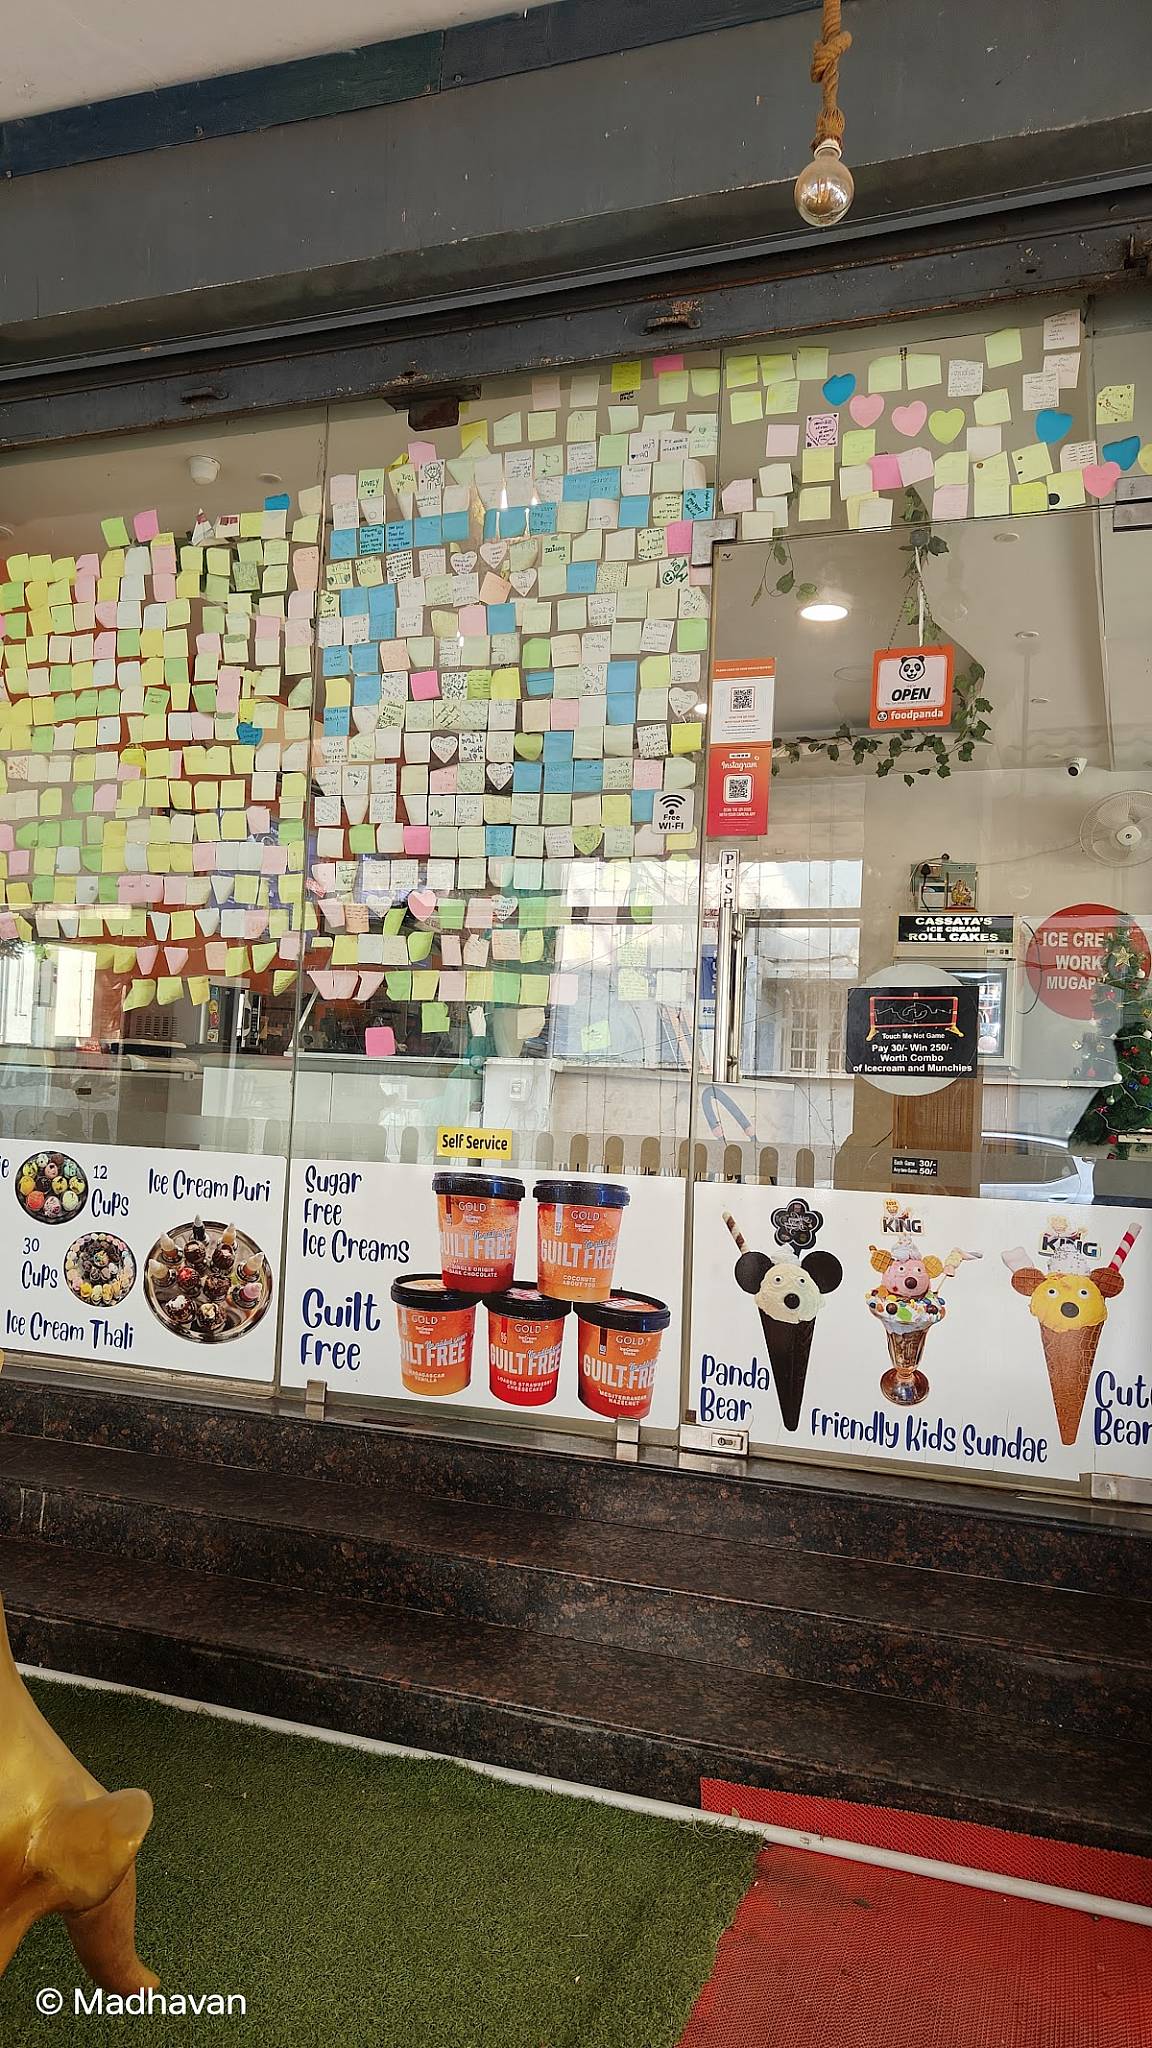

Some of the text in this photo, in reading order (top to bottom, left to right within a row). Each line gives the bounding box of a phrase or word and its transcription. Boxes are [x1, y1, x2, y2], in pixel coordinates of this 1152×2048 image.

[891, 687, 931, 702] OPEN
[891, 709, 944, 721] foodpanda
[721, 760, 758, 772] Instagram
[723, 854, 735, 908] PUSH
[915, 917, 993, 926] CASSATA'S
[908, 933, 999, 941] ROLL CAKES
[1043, 932, 1069, 947] ICE
[881, 1032, 901, 1040] Touch
[871, 1043, 953, 1053] Pay 30/- Win 250/-
[880, 1054, 944, 1062] Worth Combo
[853, 1063, 973, 1072] of Icecream and Munchies
[442, 1134, 508, 1151] Self Service
[918, 1159, 937, 1167] 30/-
[919, 1167, 937, 1176] 50/-
[93, 1165, 108, 1180] 12
[305, 1165, 362, 1197] Sugar
[149, 1168, 271, 1203] Ice Cream Puri
[91, 1188, 129, 1217] Cups
[458, 1201, 487, 1213] GOLD
[304, 1198, 342, 1226] Free
[571, 1210, 600, 1221] GOLD
[882, 1219, 922, 1233] KING
[22, 1237, 40, 1255] 30
[303, 1227, 410, 1264] Ice Creams
[541, 1239, 583, 1269] GUILT
[21, 1260, 59, 1289] Cups
[463, 1270, 498, 1278] CHOCOLATE
[302, 1287, 381, 1332] Guilt
[411, 1314, 439, 1325] GOLD
[6, 1309, 134, 1350] Ice Cream Thali
[514, 1324, 542, 1334] GOLD
[615, 1335, 645, 1346] GOLD
[300, 1333, 361, 1371] Free
[426, 1339, 466, 1367] FREE
[490, 1343, 527, 1375] GUILT
[583, 1354, 628, 1389] GUILT
[701, 1353, 770, 1391] Panda
[1094, 1370, 1152, 1409] Cut
[700, 1386, 752, 1422] Bear
[1094, 1406, 1152, 1446] Bear
[811, 1408, 1048, 1463] Friendly Kids Sundae
